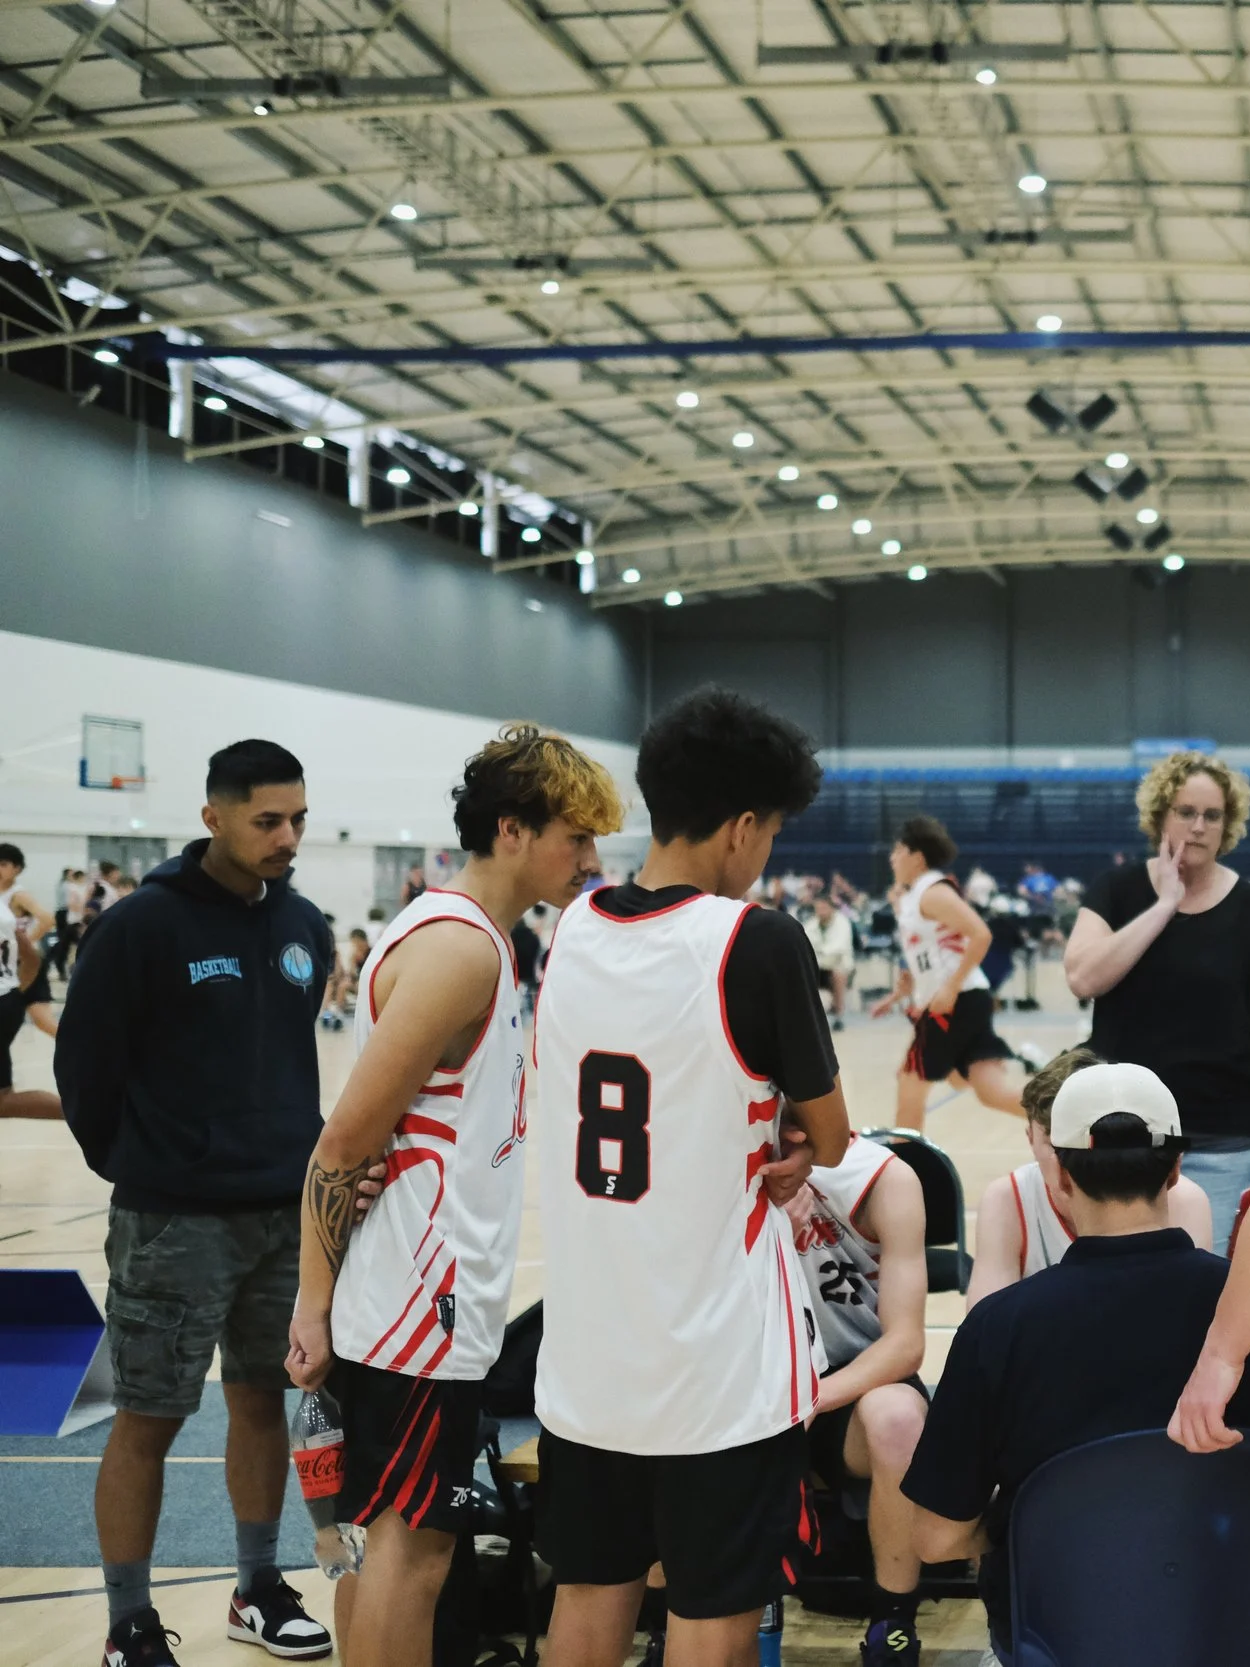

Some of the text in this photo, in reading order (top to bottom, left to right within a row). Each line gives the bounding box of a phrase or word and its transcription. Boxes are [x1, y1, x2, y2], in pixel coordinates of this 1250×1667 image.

[188, 957, 242, 985] BASKETBALL
[575, 1049, 651, 1204] 8
[819, 1260, 864, 1306] 25
